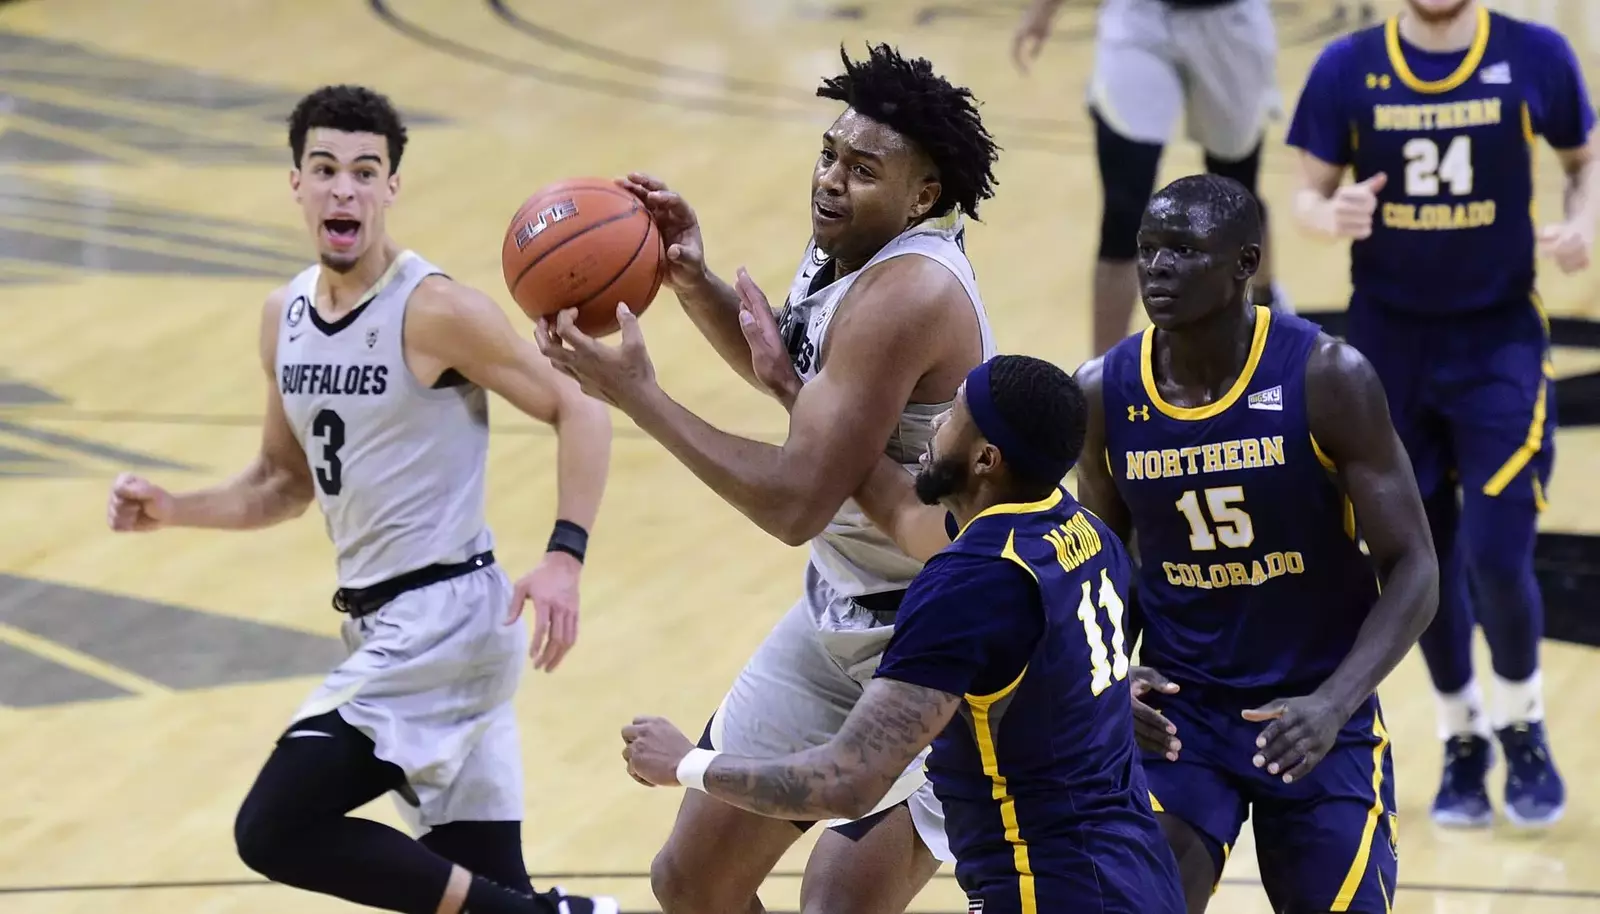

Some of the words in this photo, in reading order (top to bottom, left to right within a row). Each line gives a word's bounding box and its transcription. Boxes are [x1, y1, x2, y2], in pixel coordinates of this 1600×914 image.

[1403, 134, 1473, 196] 24
[1382, 199, 1497, 230] COLORADO
[282, 364, 389, 396] BUFFALOES
[313, 408, 345, 496] 3
[1126, 435, 1286, 480] NORTHERN
[1175, 485, 1255, 551] 15
[1162, 551, 1305, 590] COLORADO
[1077, 567, 1129, 697] 11
